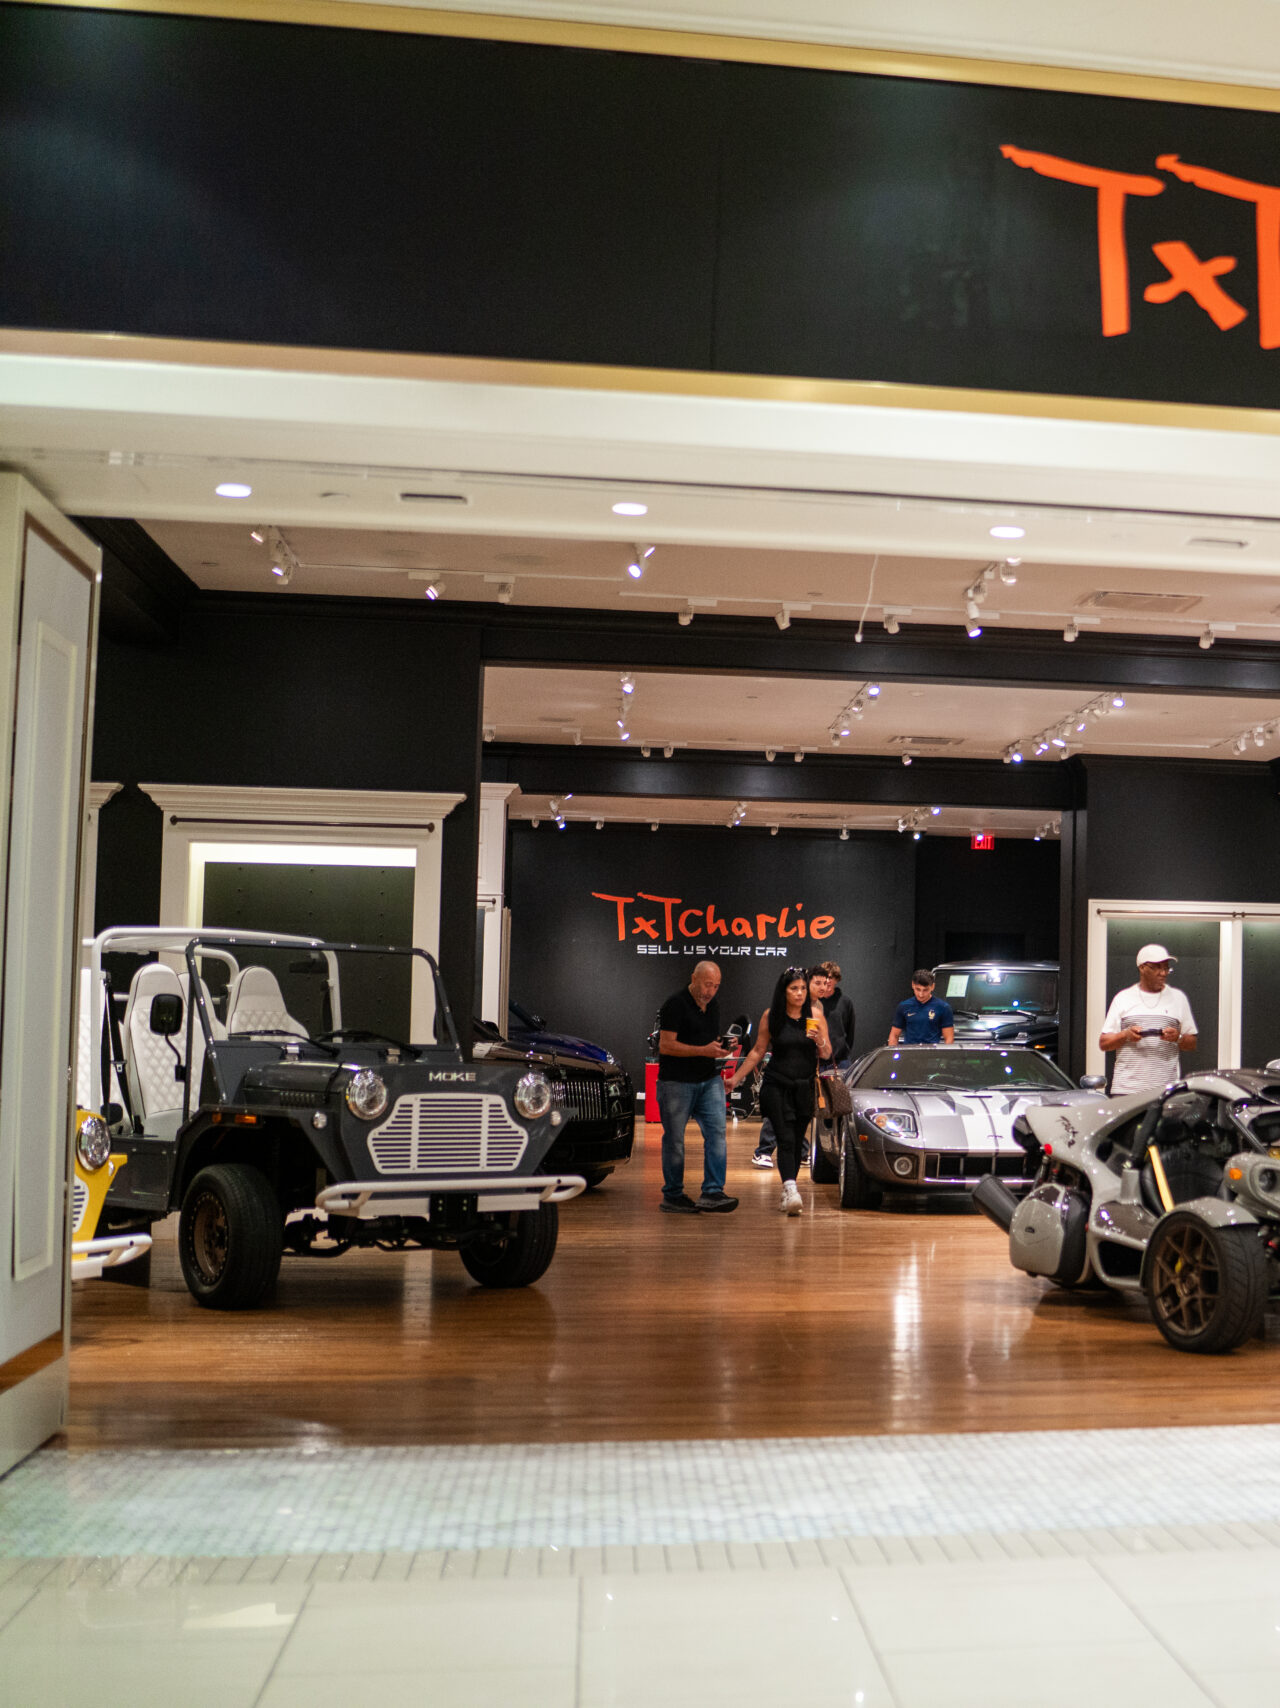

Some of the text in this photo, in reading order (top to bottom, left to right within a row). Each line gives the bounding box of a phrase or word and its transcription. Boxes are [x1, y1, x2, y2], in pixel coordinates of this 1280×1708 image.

[637, 944, 679, 954] SELL
[755, 946, 788, 957] CAR
[428, 1071, 477, 1082] MOKE
